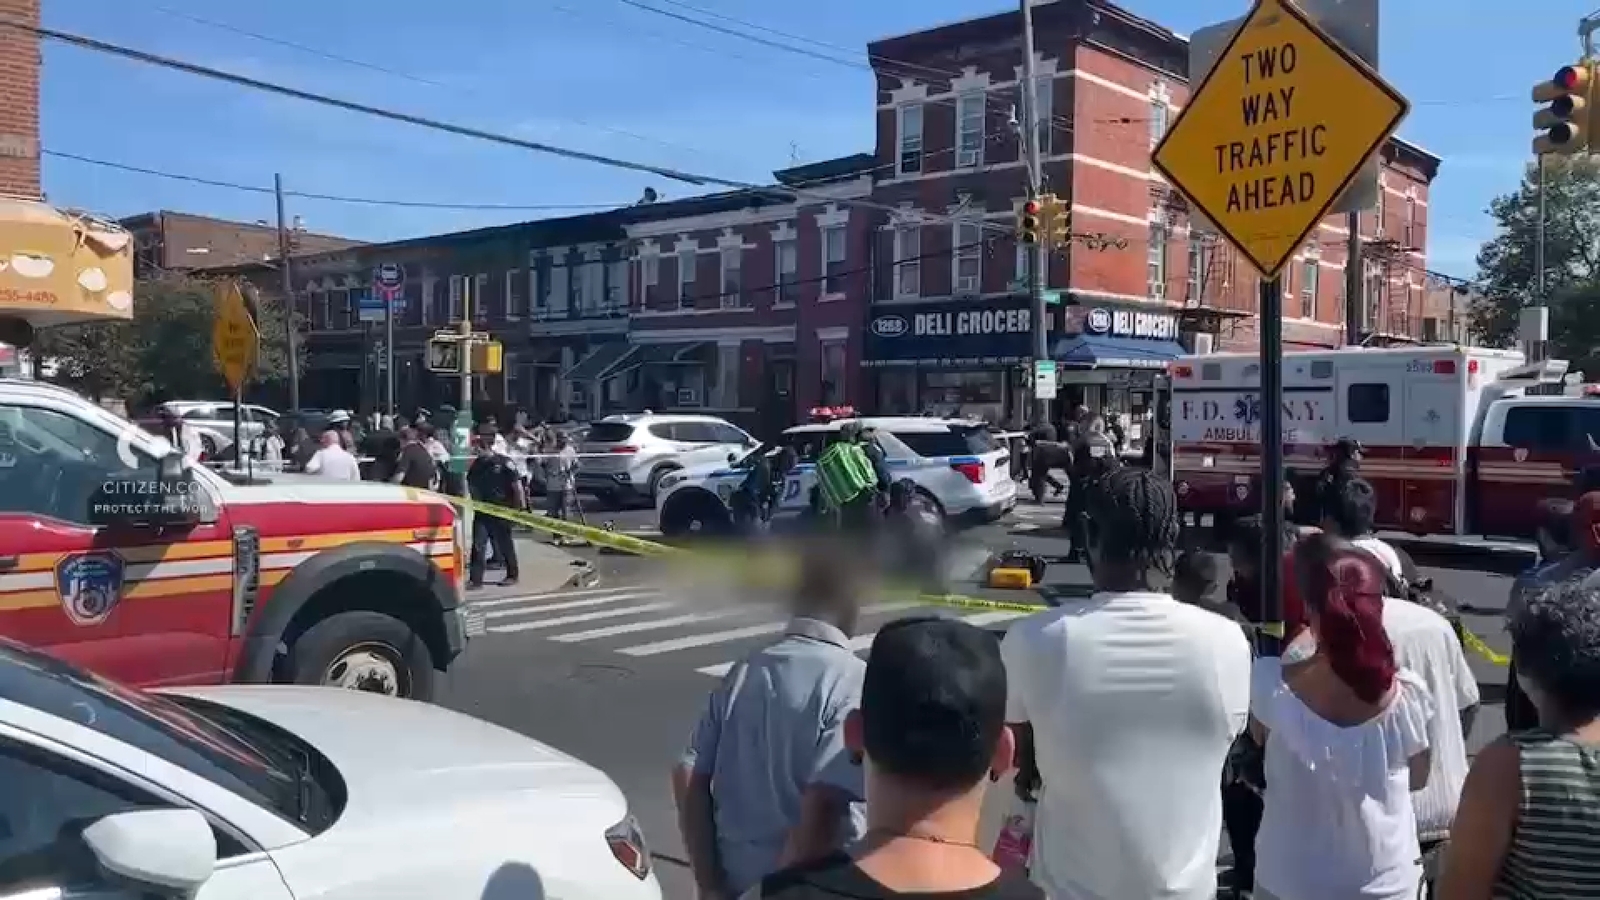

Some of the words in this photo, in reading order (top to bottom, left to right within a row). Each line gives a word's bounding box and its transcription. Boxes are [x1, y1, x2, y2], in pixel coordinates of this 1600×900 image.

[1241, 43, 1296, 84] TWO
[1241, 86, 1295, 126] WAY
[1214, 124, 1326, 174] TRAFFIC
[1226, 172, 1315, 213] AHEAD
[914, 312, 953, 336] DELI
[957, 309, 1031, 335] GROCER
[1112, 310, 1134, 335] DELI
[1182, 400, 1225, 421] F.D.
[1203, 426, 1298, 441] AMBULCE
